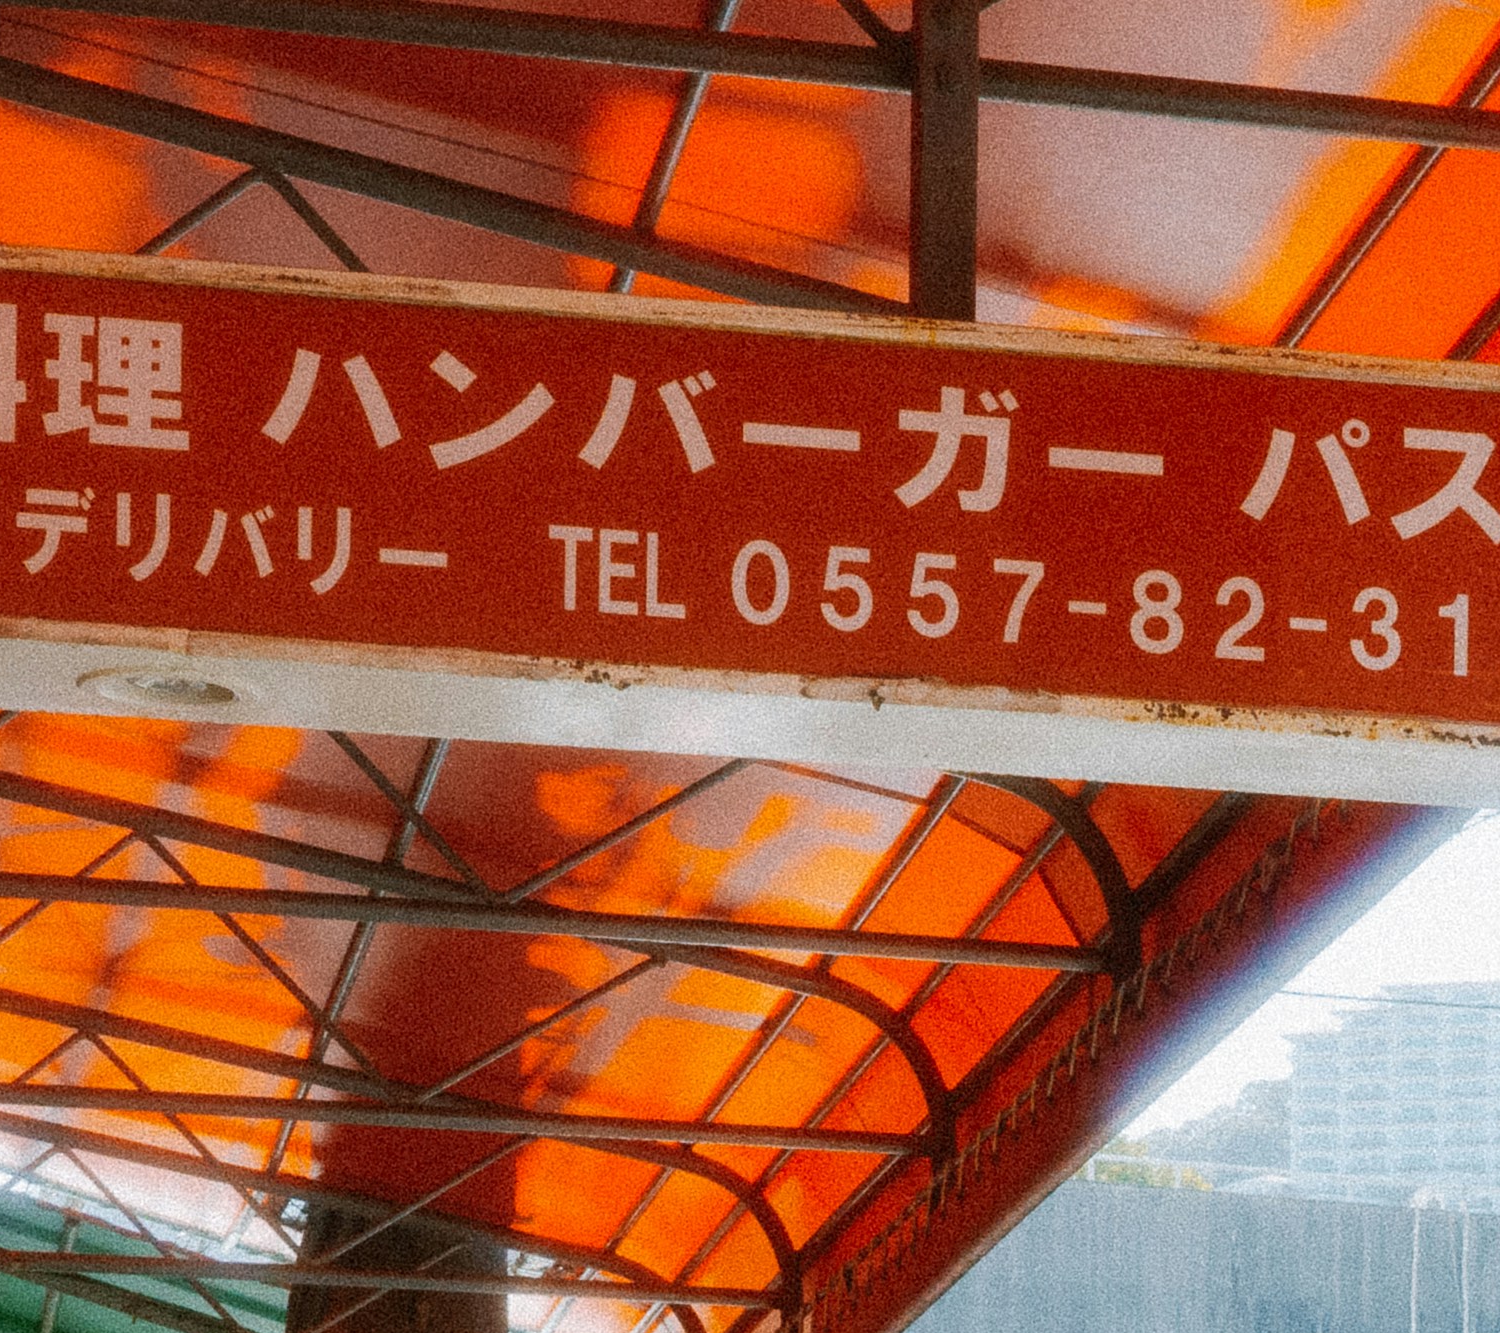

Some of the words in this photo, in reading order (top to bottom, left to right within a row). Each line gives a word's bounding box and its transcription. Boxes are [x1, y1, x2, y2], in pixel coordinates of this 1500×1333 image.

[262, 345, 1165, 513] ハンバーガー
[549, 522, 687, 620] TEL
